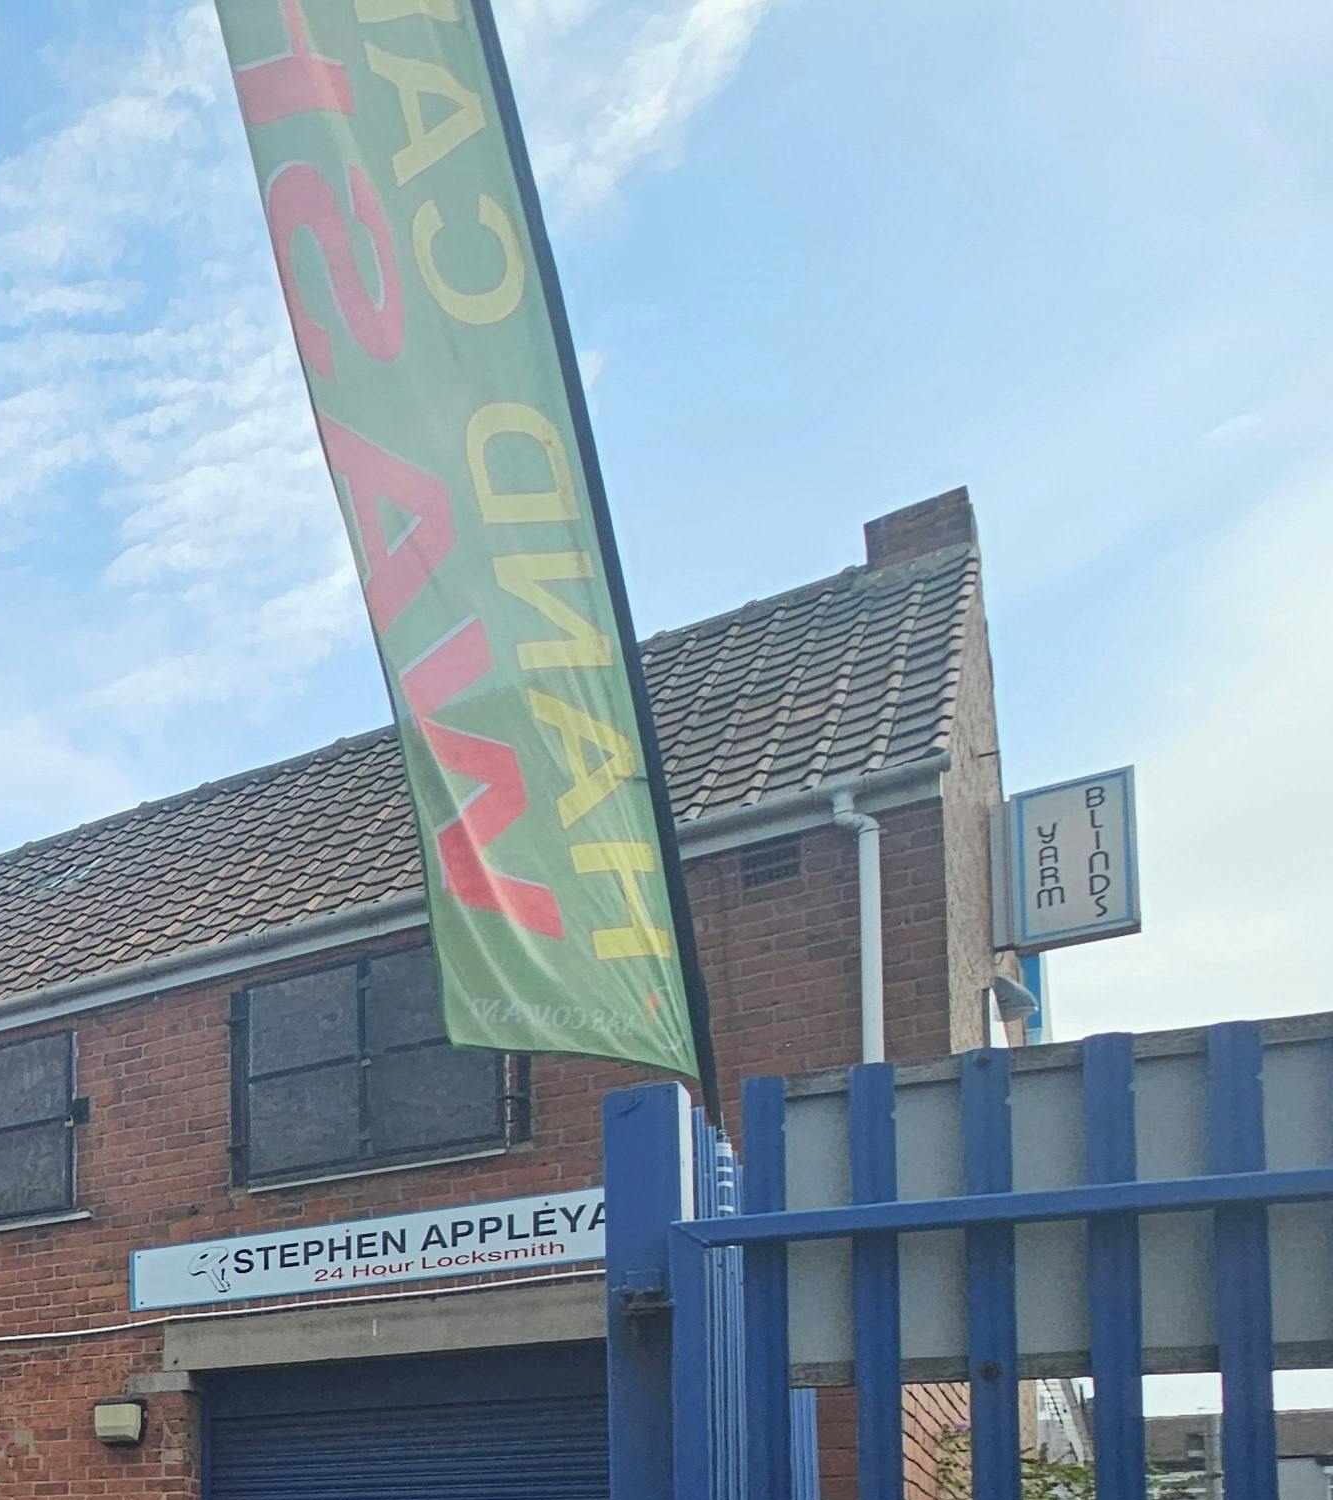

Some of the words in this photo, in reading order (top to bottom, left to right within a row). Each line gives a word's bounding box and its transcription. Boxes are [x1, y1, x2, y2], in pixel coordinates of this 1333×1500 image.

[233, 1228, 408, 1275] STEPHEN
[314, 1267, 345, 1283] 24
[351, 1260, 415, 1279] Hour
[421, 1240, 566, 1270] Locksmith
